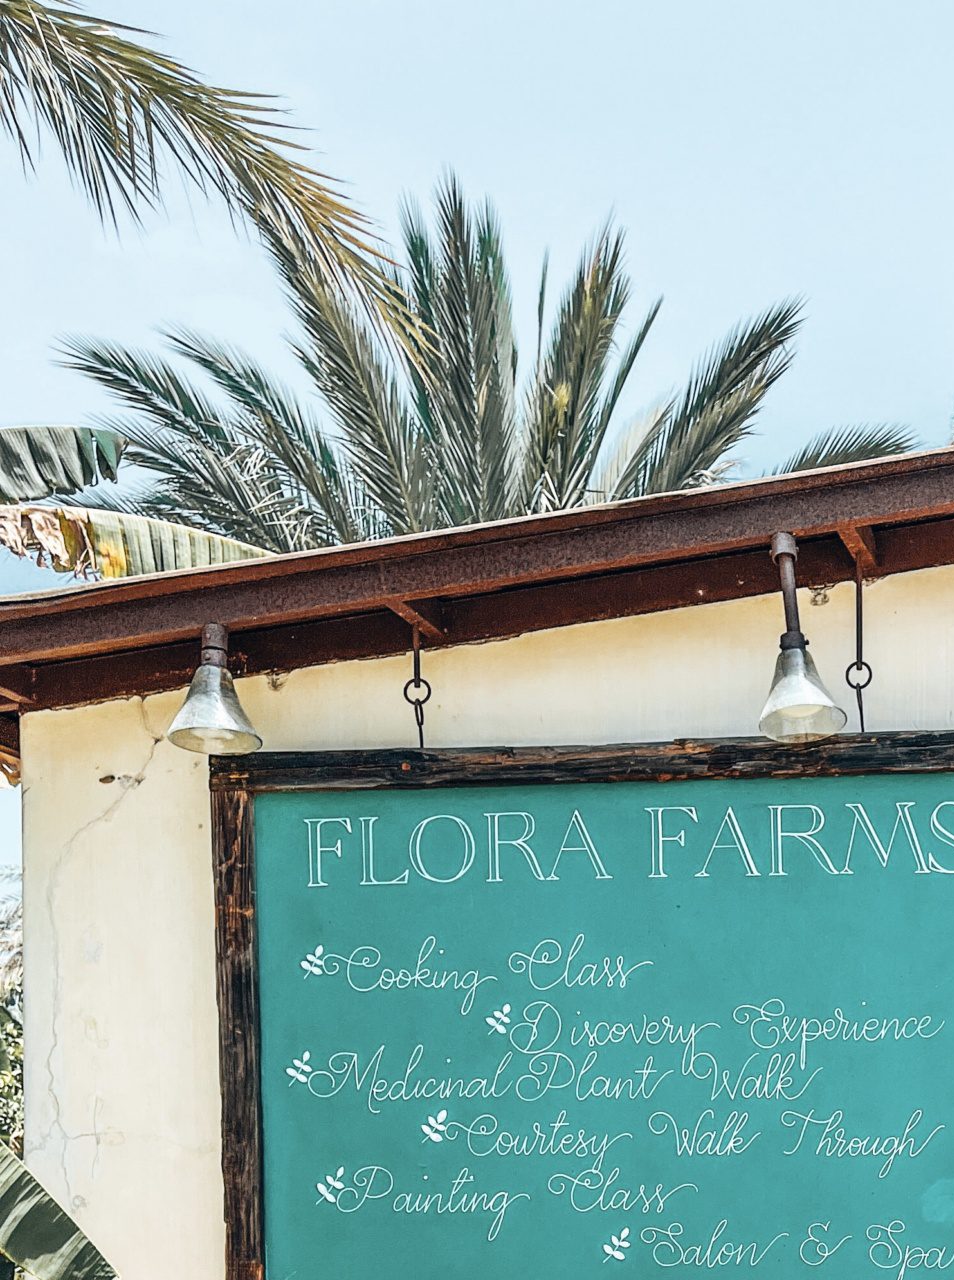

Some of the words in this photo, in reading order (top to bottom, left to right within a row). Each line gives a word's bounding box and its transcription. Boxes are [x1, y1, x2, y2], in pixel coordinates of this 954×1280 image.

[304, 810, 613, 887] FLORA
[323, 936, 498, 1015] Cooking
[509, 934, 653, 990] Class
[510, 1001, 720, 1075] Discovery
[733, 999, 945, 1070] Experience
[308, 1045, 513, 1113] Medicinal
[516, 1052, 675, 1101] Plant
[690, 1052, 823, 1100] Walk
[445, 1110, 632, 1173] Courtesy
[649, 1109, 761, 1156] Walk
[781, 1110, 945, 1178] Through
[336, 1166, 530, 1241] Painting
[548, 1168, 698, 1213] Class
[641, 1219, 789, 1268] Salon
[800, 1221, 852, 1265] &
